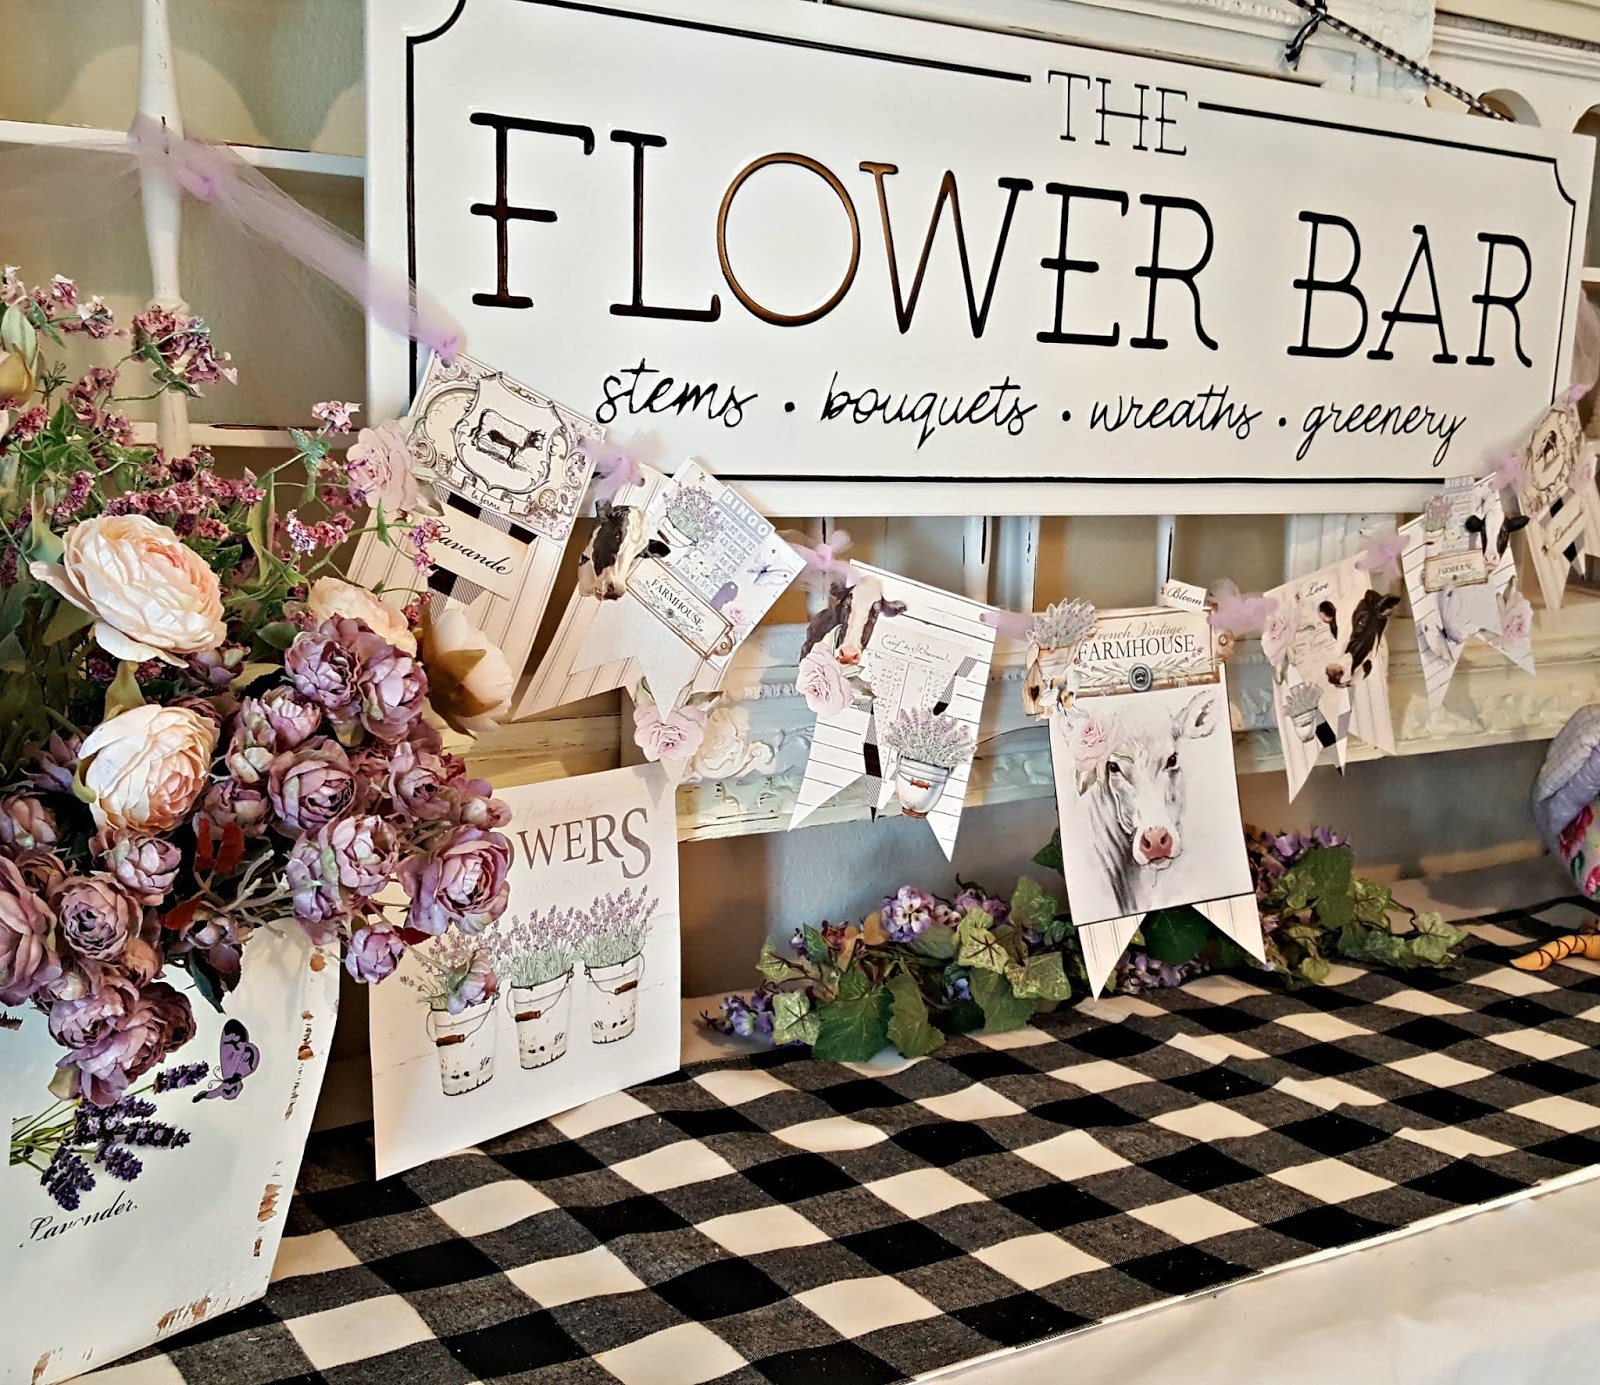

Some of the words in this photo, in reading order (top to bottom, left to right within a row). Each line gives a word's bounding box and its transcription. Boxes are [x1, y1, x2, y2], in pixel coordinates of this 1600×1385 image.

[1048, 71, 1188, 156] THE
[470, 112, 1218, 351] FLOWER
[1287, 211, 1532, 368] BAR
[596, 358, 758, 428] stems
[821, 371, 1038, 450] bouquets
[1090, 384, 1262, 440] wreaths
[1296, 402, 1466, 467] greenery
[722, 491, 769, 536] BINGO
[650, 578, 705, 627] FARMHOUSE
[1166, 586, 1202, 606] Bloom
[1306, 581, 1330, 598] Love
[1078, 634, 1196, 662] FARMHOUSE
[1136, 621, 1186, 644] Vintage
[505, 807, 652, 879] WERS
